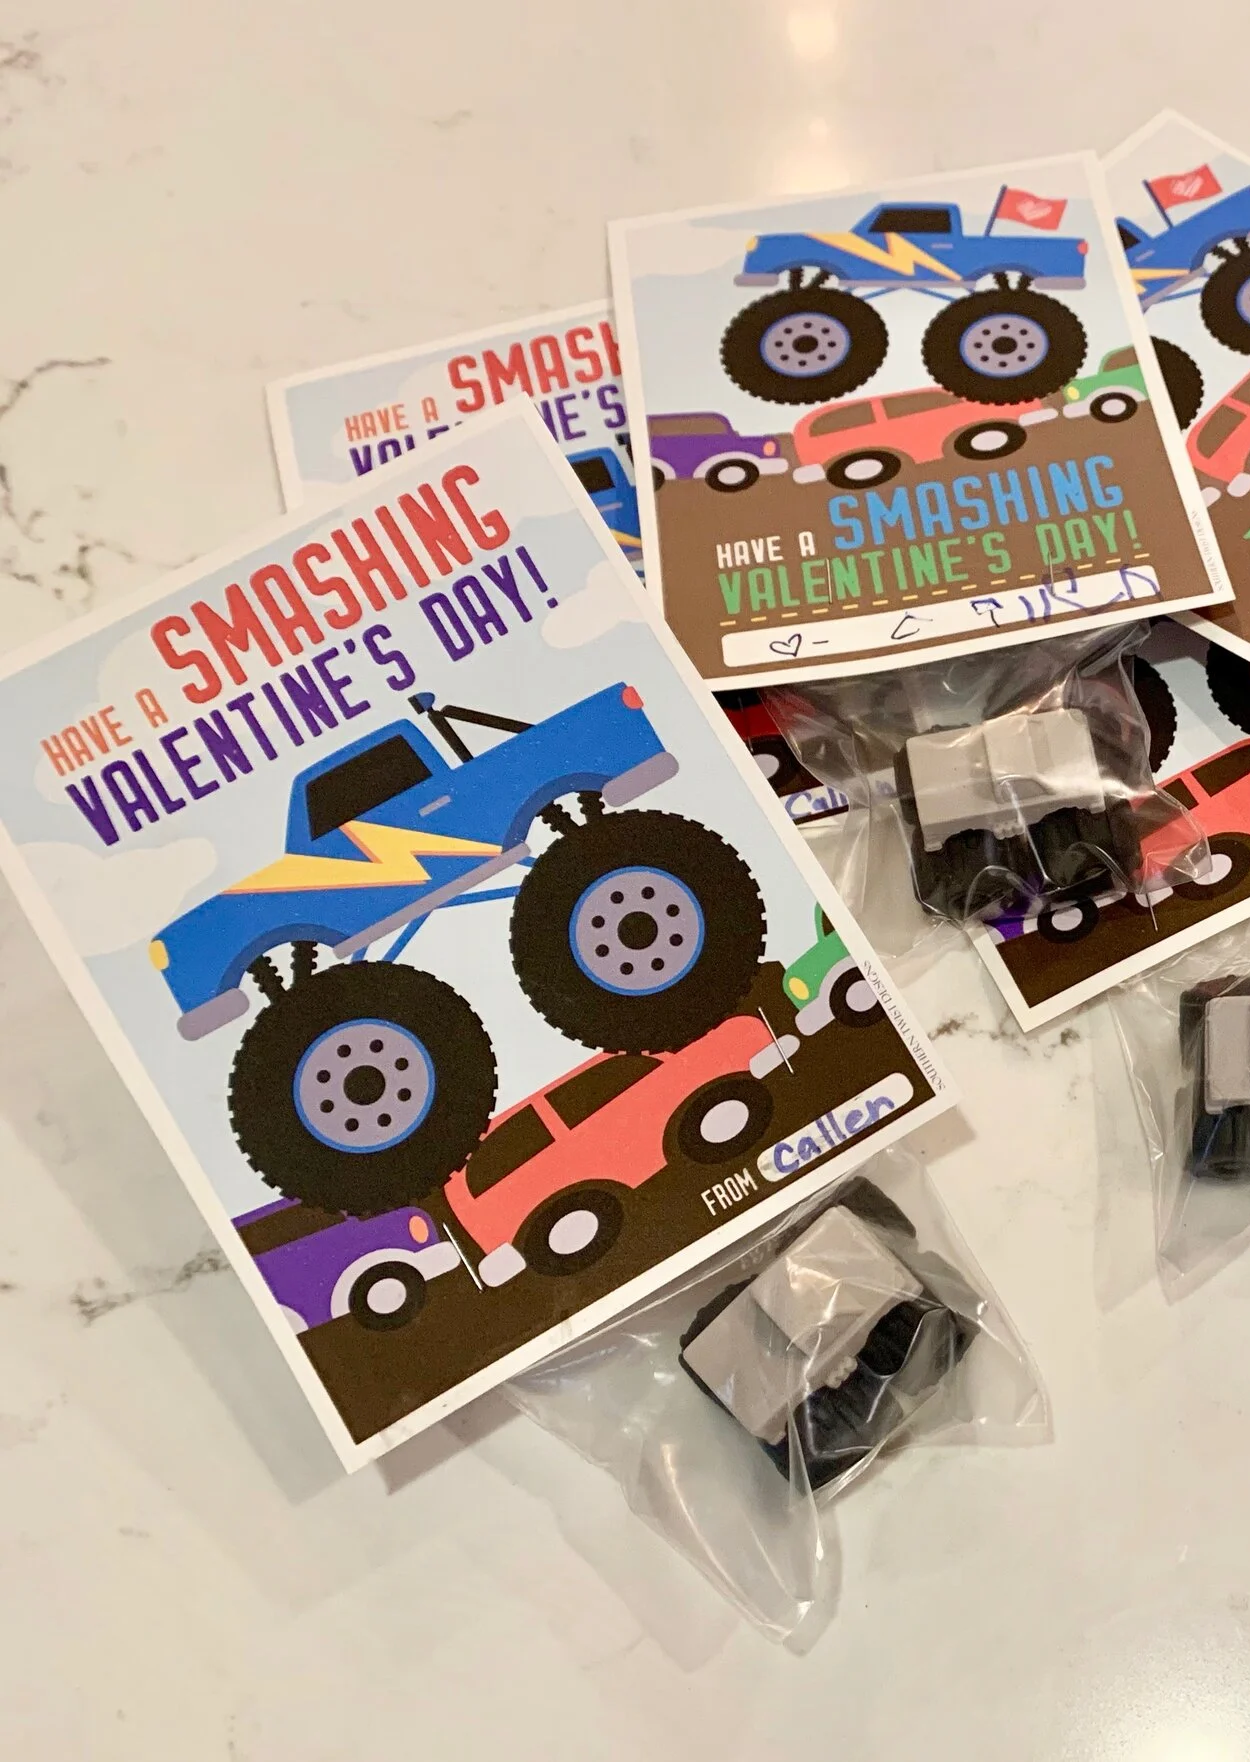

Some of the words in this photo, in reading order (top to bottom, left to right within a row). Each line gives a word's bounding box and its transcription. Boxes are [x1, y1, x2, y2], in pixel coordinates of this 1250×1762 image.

[344, 403, 409, 442] HAVE
[421, 396, 440, 423] A
[715, 533, 782, 570] HAVE
[798, 530, 816, 557] A
[827, 454, 1124, 552] SMASHING
[149, 463, 512, 704] SMASHING
[717, 530, 1013, 616] VALENTINE'S
[1034, 510, 1145, 569] DAY!
[64, 622, 417, 847] VALENTINE'S
[418, 546, 560, 663] DAY!
[135, 687, 168, 725] A
[41, 705, 134, 778] HAVE
[863, 960, 893, 1004] DESIGNS
[888, 1004, 911, 1035] TWIST
[907, 1035, 946, 1091] SOUTHERN
[700, 1167, 760, 1216] FROM
